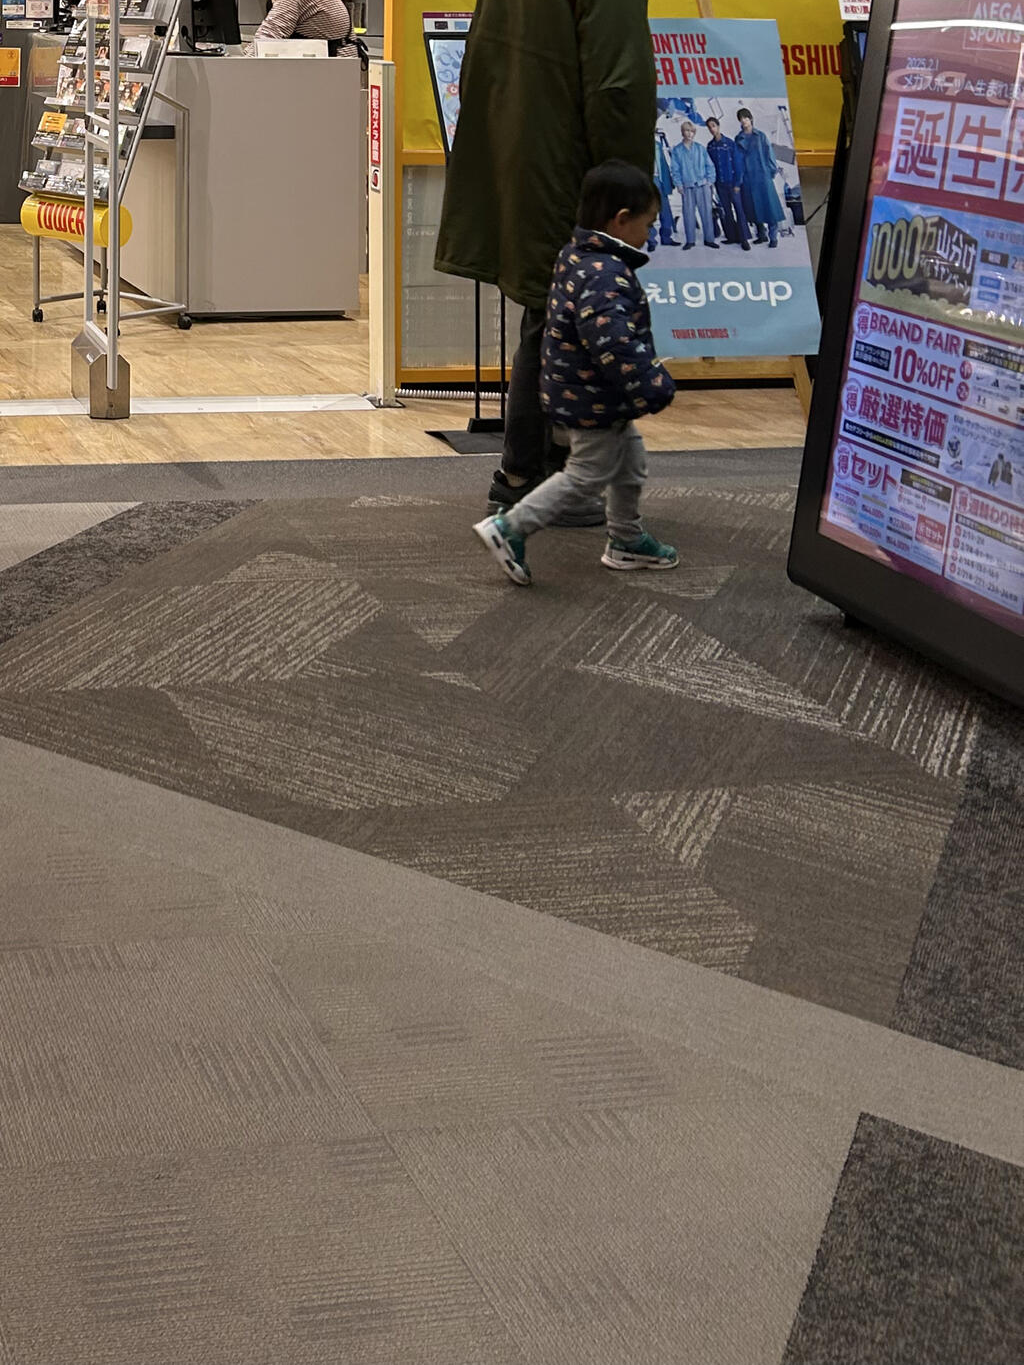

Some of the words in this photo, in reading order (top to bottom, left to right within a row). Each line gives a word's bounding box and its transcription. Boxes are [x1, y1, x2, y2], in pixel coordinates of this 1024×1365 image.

[974, 2, 1023, 21] MEGA
[651, 33, 707, 55] ONTHLY
[678, 57, 744, 86] PUSH!
[894, 109, 1024, 194] 誕生
[37, 201, 85, 235] TOWER
[681, 280, 793, 308] group
[671, 329, 696, 339] TOWER
[697, 329, 729, 339] RECORDS
[870, 312, 924, 344] BRAND
[926, 327, 961, 357] FAIR
[893, 345, 956, 392] 10%OFF
[859, 385, 946, 450] 厳選特価
[851, 452, 898, 495] セット
